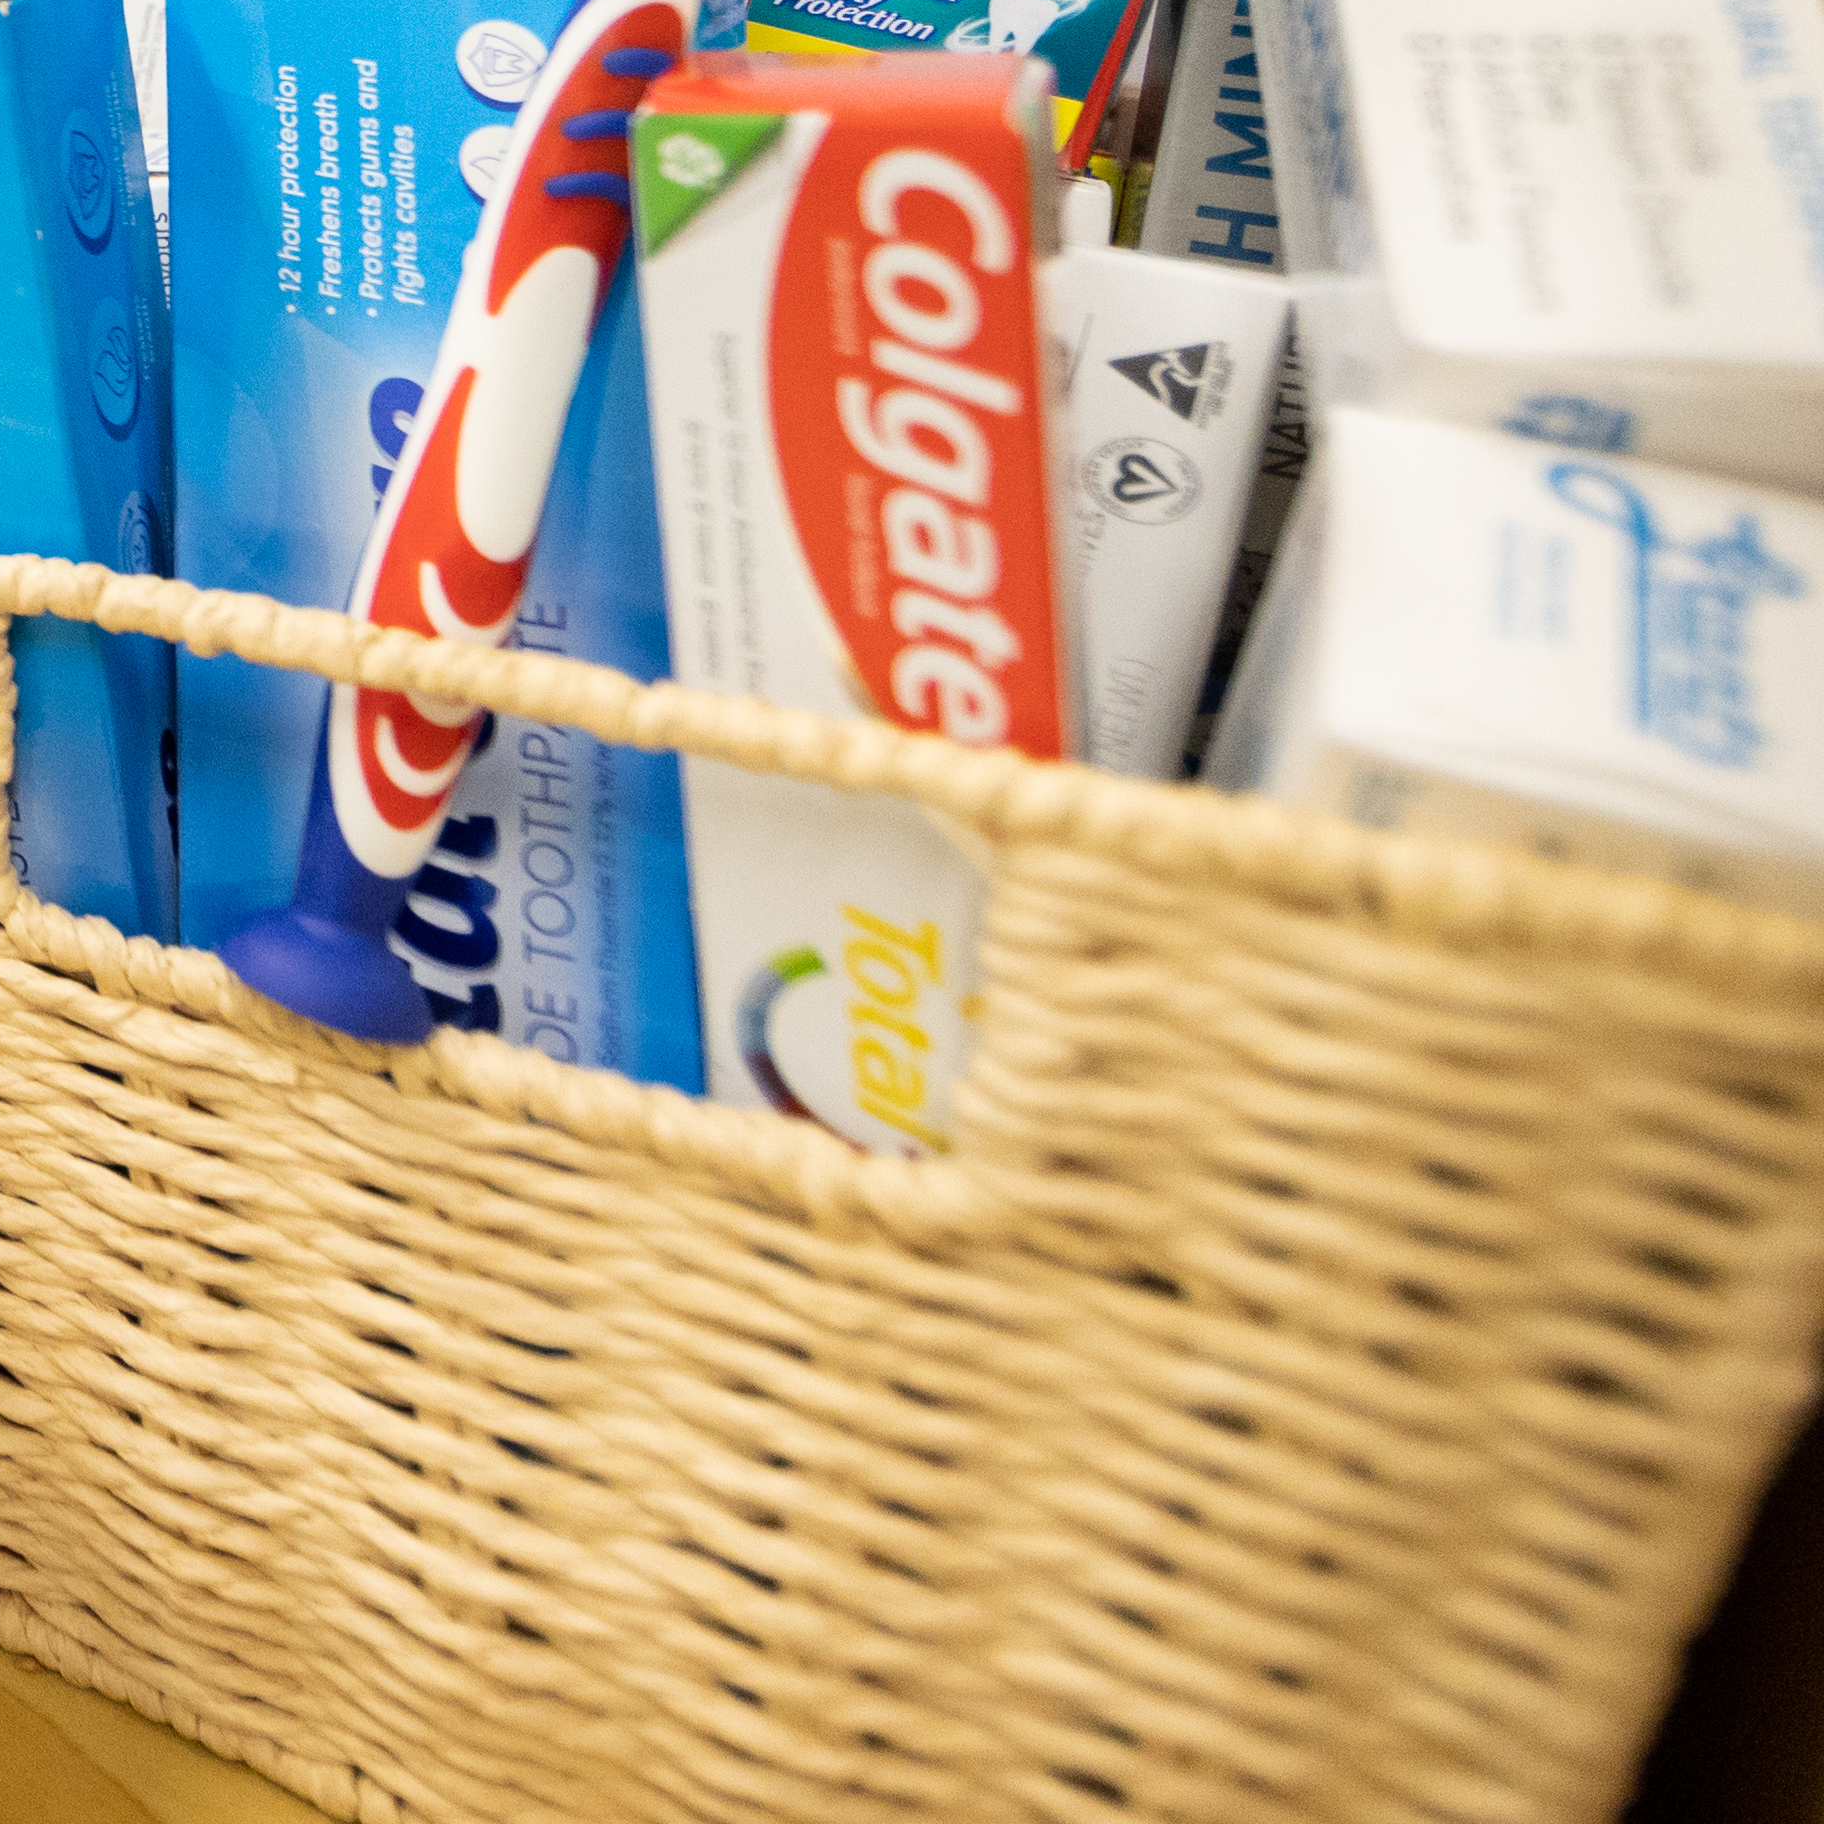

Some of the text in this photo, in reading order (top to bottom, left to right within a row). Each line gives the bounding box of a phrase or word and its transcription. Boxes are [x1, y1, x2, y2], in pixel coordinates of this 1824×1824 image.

[274, 65, 306, 292] 12 hour protection
[313, 93, 342, 298] Freshens breath
[351, 57, 387, 300] Protects gums and
[388, 125, 425, 305] fights cavities
[837, 148, 1025, 750] Colgate
[514, 599, 577, 966] TOOTHPTE
[841, 901, 948, 1155] Total
